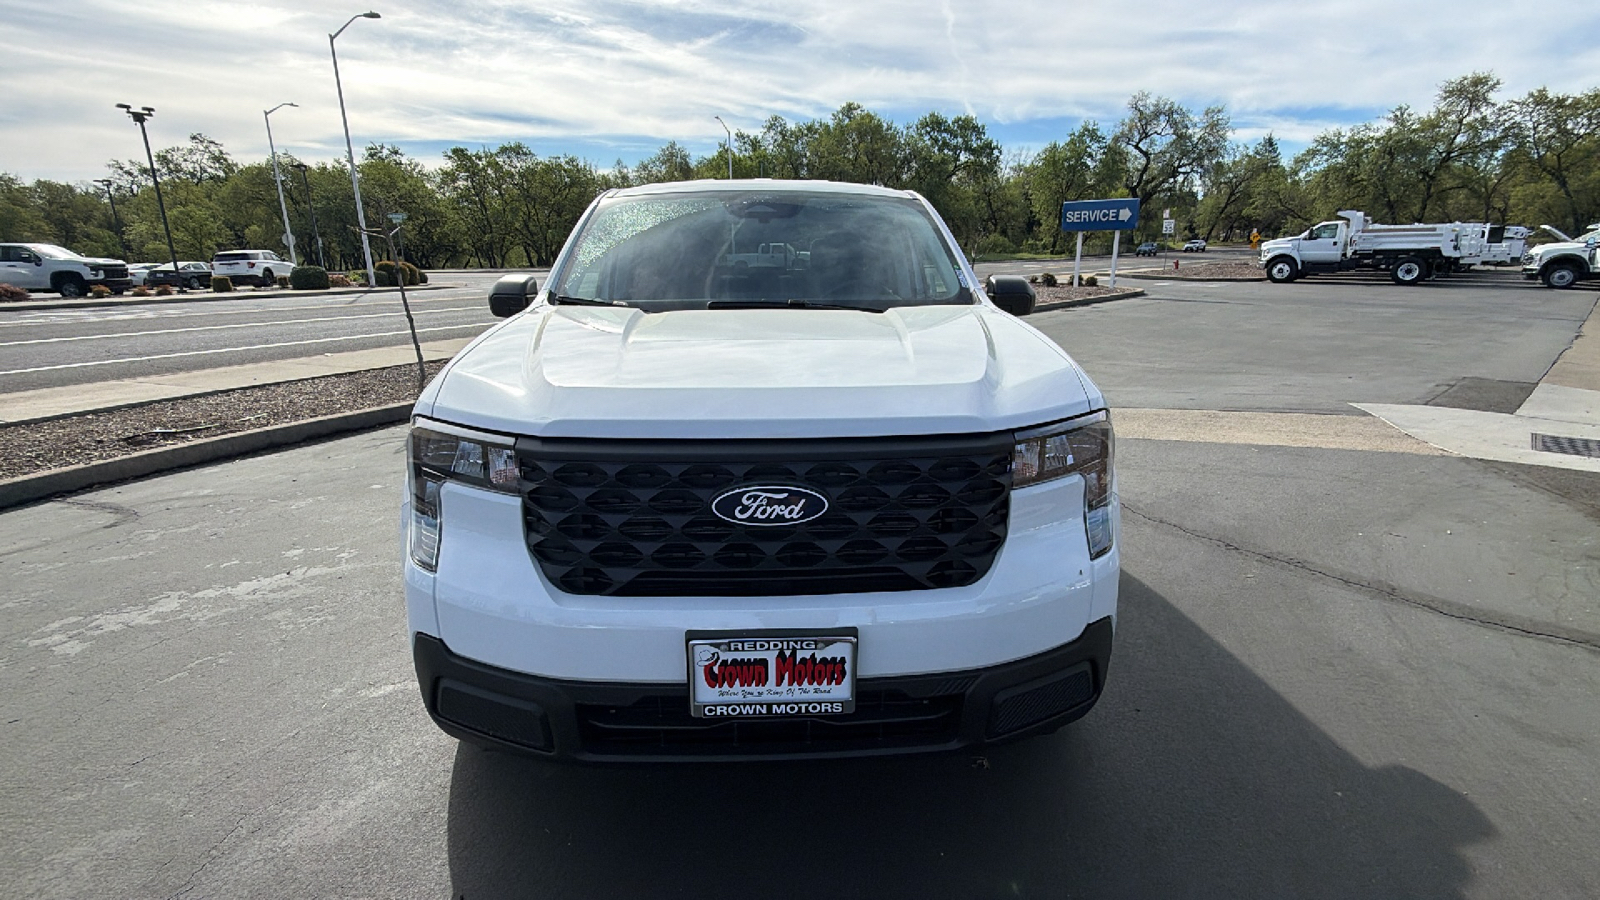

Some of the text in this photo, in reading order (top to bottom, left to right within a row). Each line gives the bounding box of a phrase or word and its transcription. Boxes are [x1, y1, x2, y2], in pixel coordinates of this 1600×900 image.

[1066, 209, 1117, 223] SERVICE
[734, 491, 806, 519] Ford
[730, 641, 816, 650] REDDING
[703, 649, 847, 689] Crown Motors
[717, 689, 739, 697] Where
[766, 688, 783, 697] King
[786, 687, 796, 697] Of
[797, 687, 810, 695] The
[813, 687, 832, 695] Road
[704, 703, 843, 716] CROWN MOTORS
